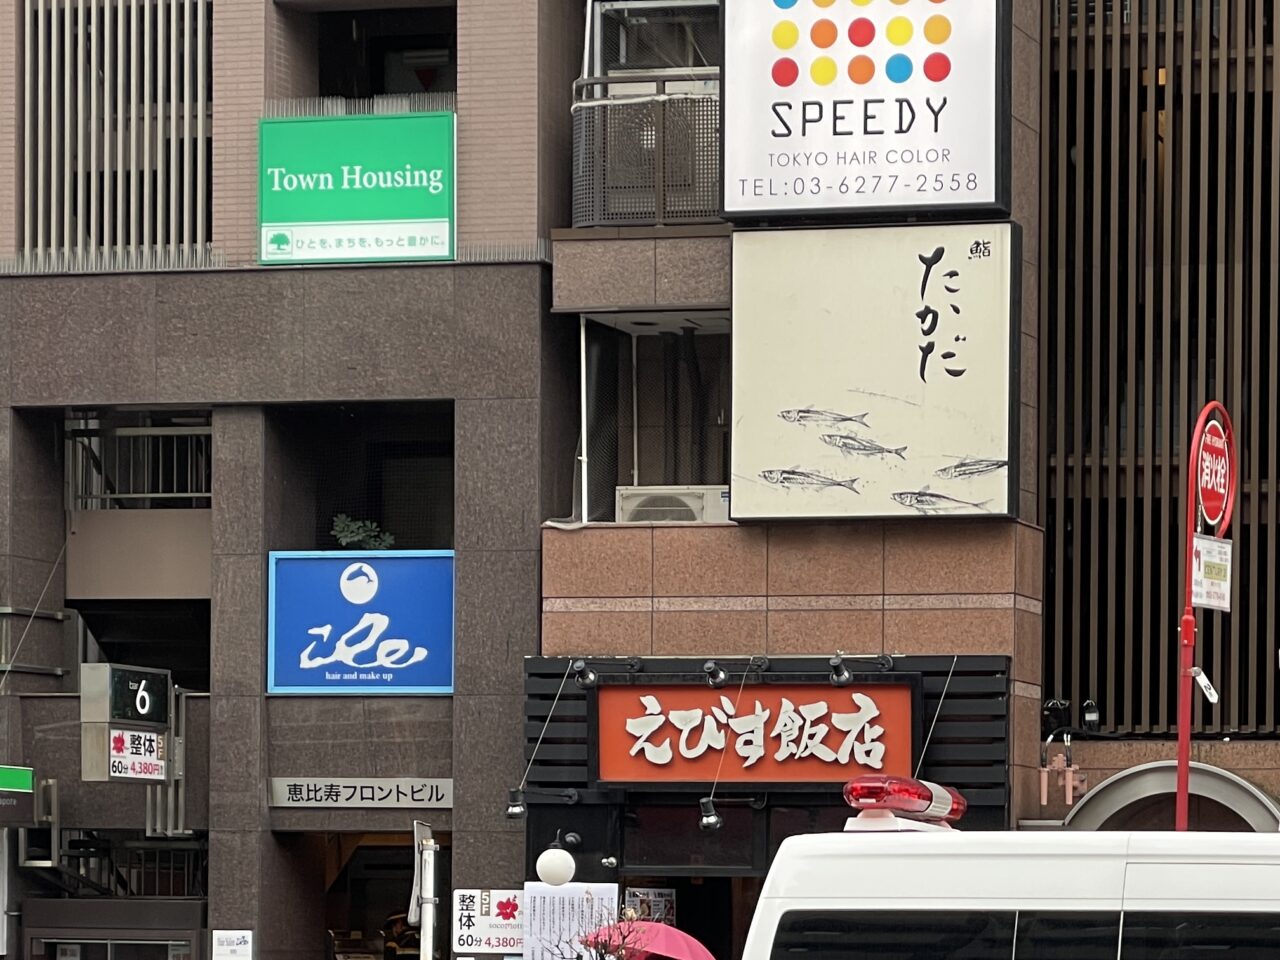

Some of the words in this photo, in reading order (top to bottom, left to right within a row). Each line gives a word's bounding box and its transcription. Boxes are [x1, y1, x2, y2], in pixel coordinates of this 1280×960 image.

[770, 96, 948, 138] SPEEDY
[767, 152, 829, 168] TOKYO
[836, 150, 877, 166] HAIR
[885, 148, 951, 165] COLOR
[267, 167, 334, 191] Town
[341, 164, 443, 194] Housing
[738, 172, 979, 197] TEL:03-6277-2558
[1201, 450, 1227, 495] 消火栓
[325, 671, 341, 680] hair
[342, 671, 358, 680] and
[359, 671, 381, 680] make
[382, 673, 393, 682] up
[135, 679, 150, 715] 6
[625, 692, 887, 769] えびす飯店
[129, 733, 156, 757] 整体
[286, 783, 445, 803] 恵比寿フロントビル
[458, 893, 476, 930] 整体
[458, 934, 483, 947] 60分
